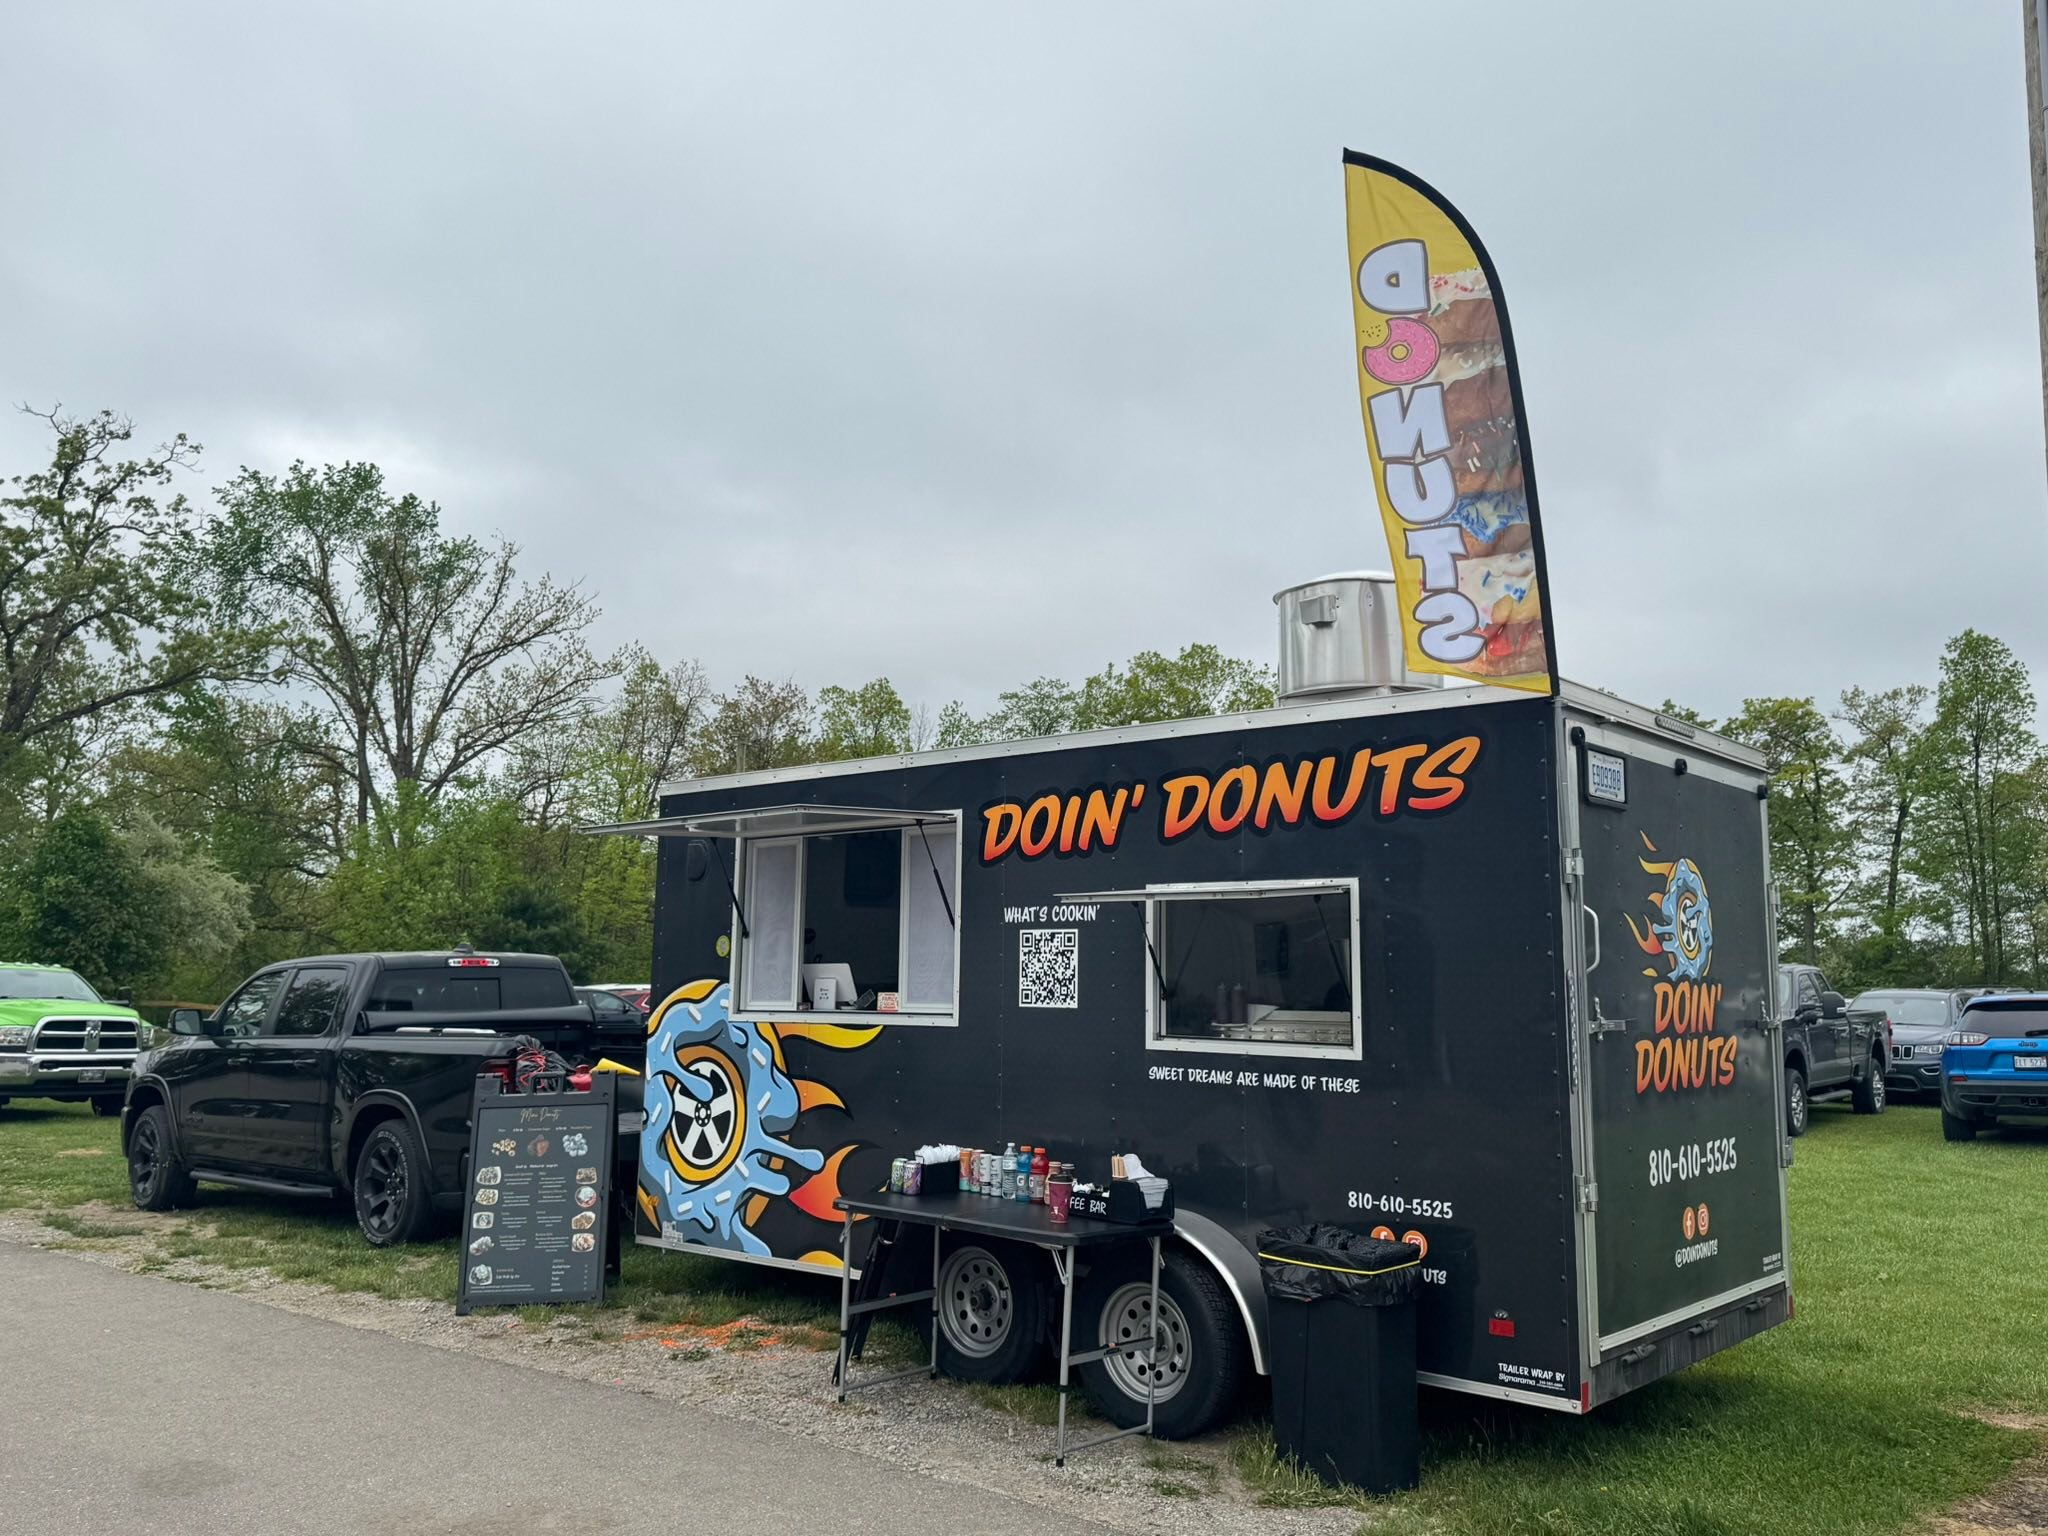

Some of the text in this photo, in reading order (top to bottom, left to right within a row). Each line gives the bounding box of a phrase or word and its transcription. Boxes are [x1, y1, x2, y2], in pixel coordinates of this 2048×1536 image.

[982, 735, 1483, 862] DOIN' DONUTS
[1003, 904, 1101, 924] WHAT'S COOKIN'
[1653, 980, 1723, 1035] DOIN'
[1635, 1035, 1739, 1095] DONUTS
[1148, 1066, 1361, 1094] SWEET DREAMS ARE MADE OF THESE
[1649, 1136, 1738, 1187] 810-610-5525
[1016, 1175, 1025, 1186] G
[1069, 1196, 1107, 1215] FEE BAR
[1347, 1190, 1454, 1219] 810-610-5525
[1422, 1267, 1448, 1285] UTS
[1497, 1362, 1566, 1383] TRAILER WRAP BY
[1498, 1373, 1536, 1386] Signarama
